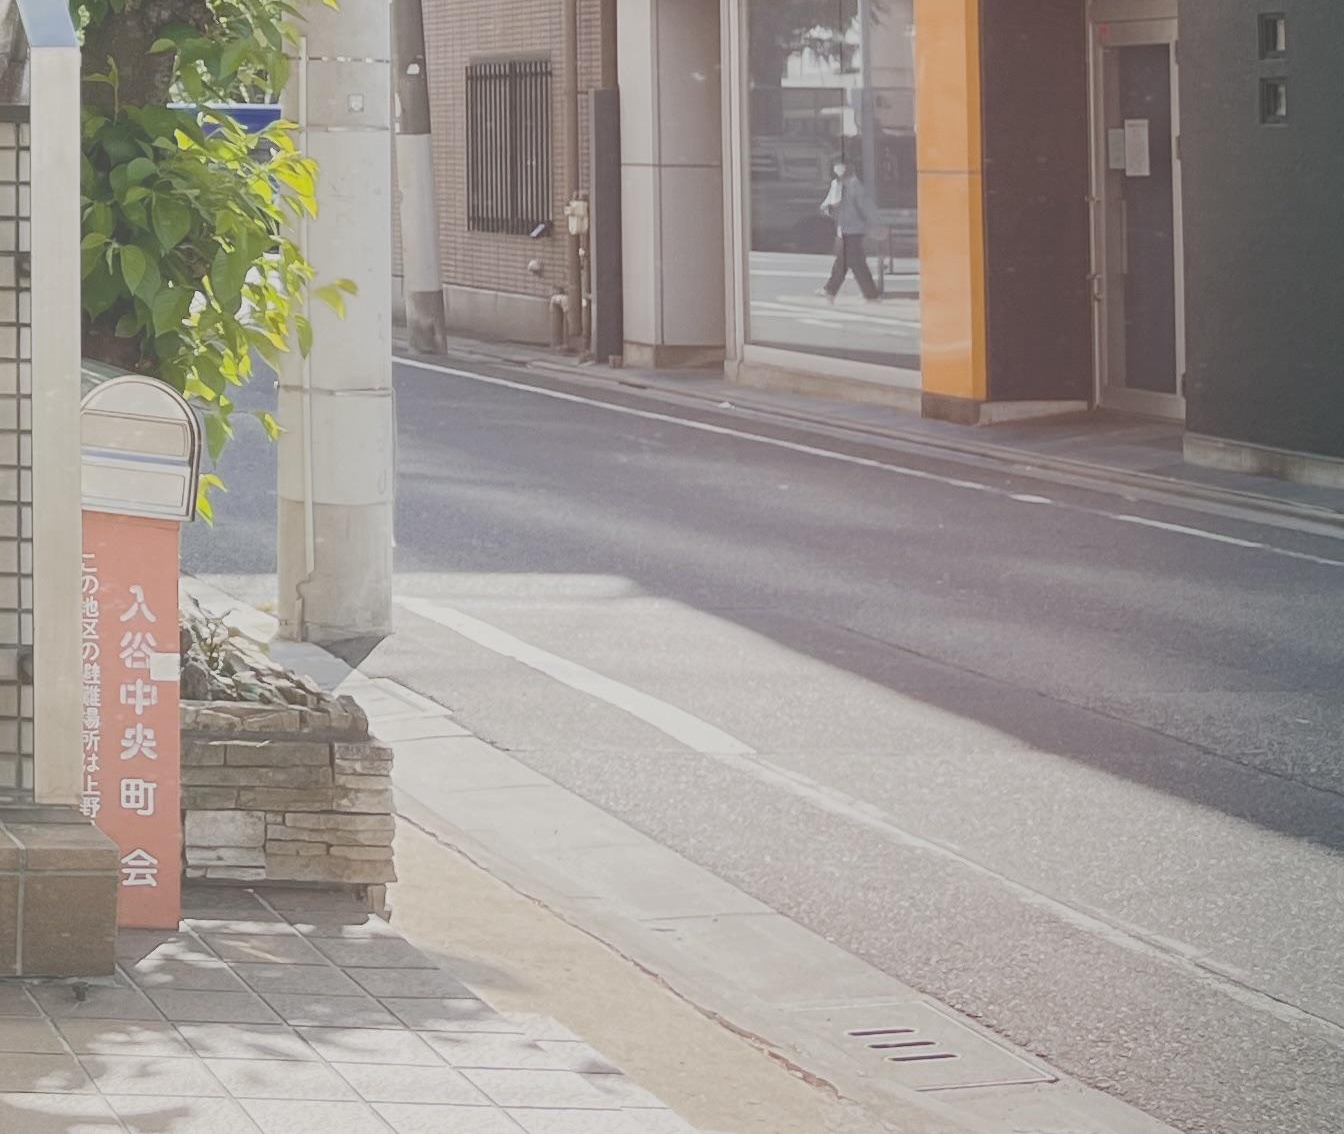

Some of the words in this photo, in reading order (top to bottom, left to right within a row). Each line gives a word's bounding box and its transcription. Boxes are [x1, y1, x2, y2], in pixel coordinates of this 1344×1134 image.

[119, 584, 158, 888] 入谷中央町会
